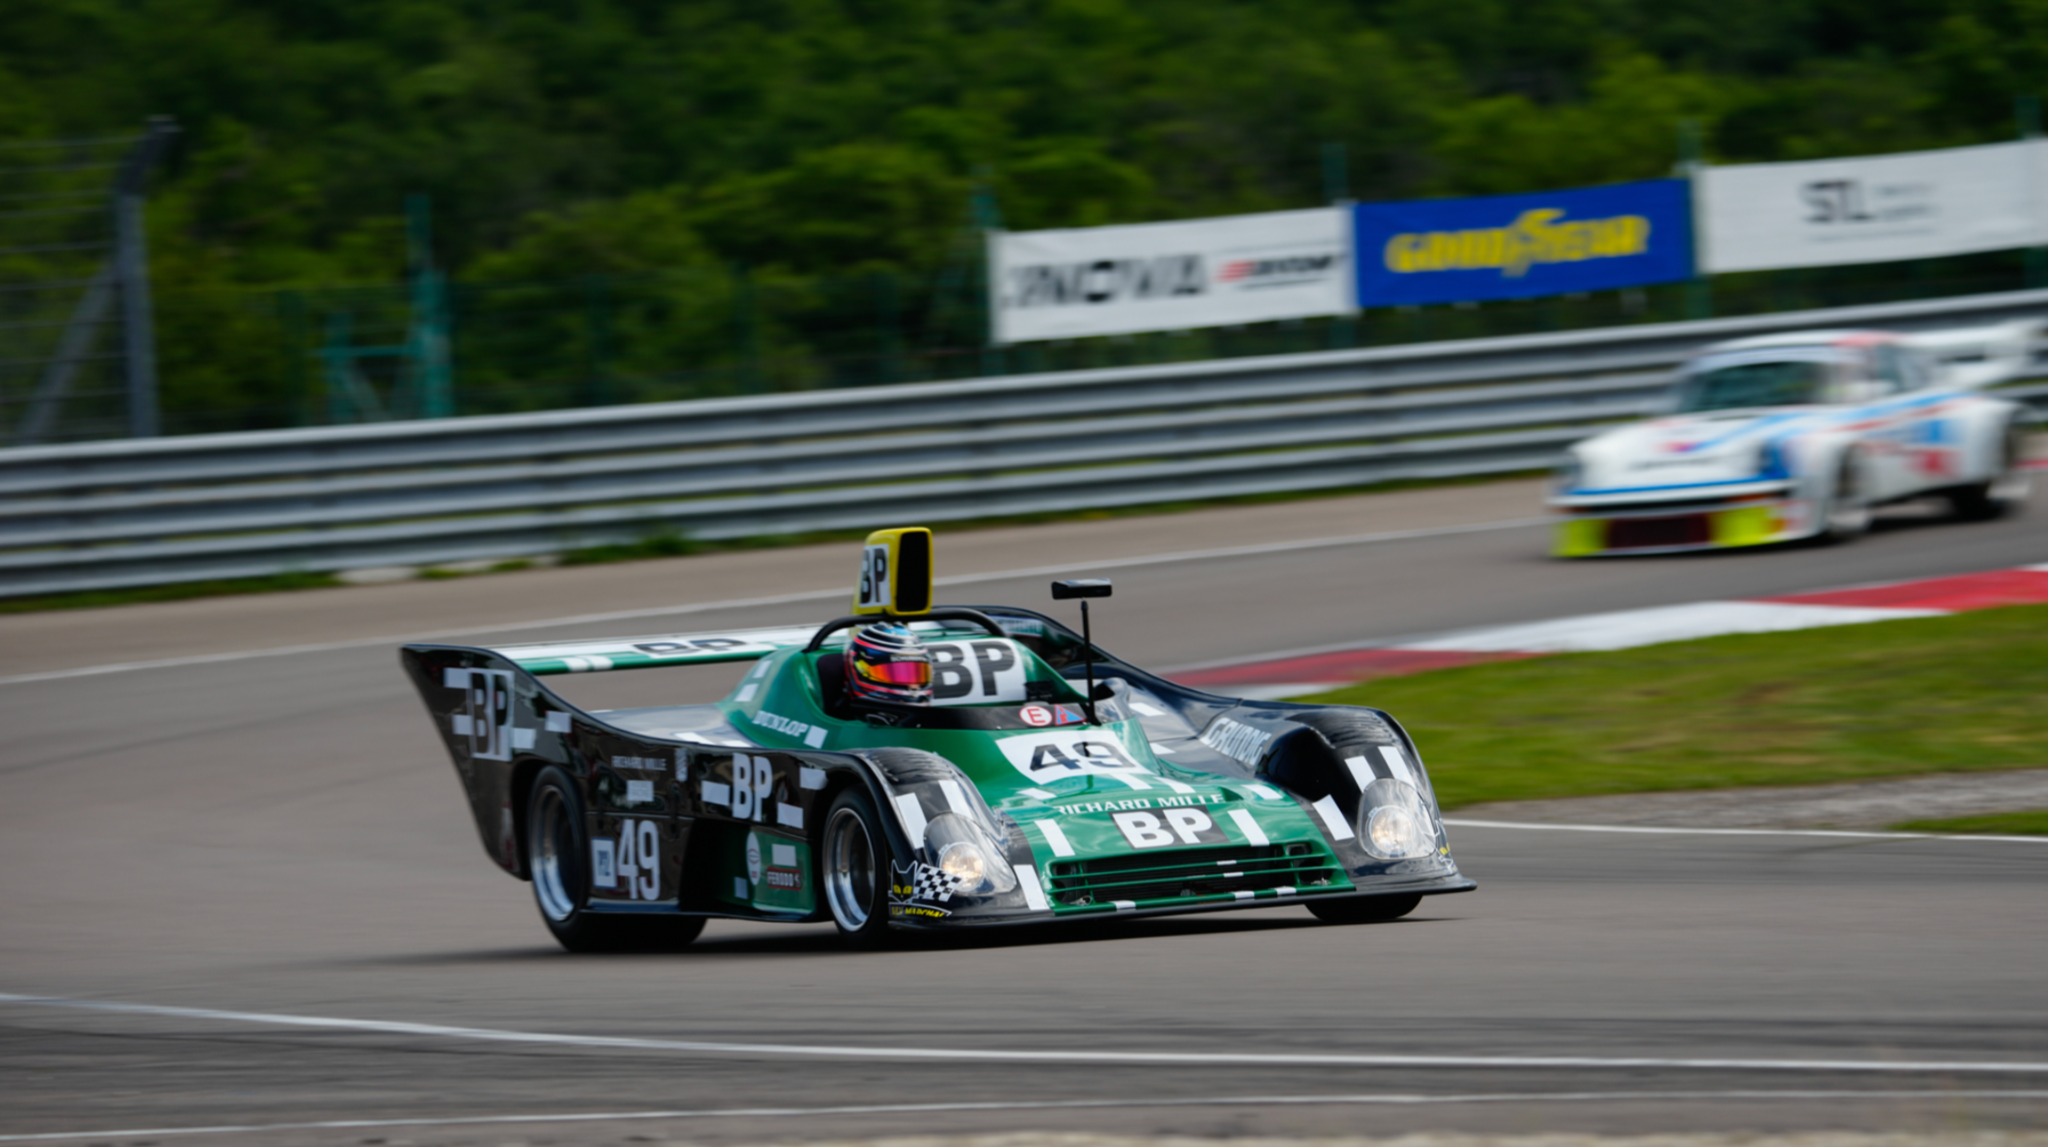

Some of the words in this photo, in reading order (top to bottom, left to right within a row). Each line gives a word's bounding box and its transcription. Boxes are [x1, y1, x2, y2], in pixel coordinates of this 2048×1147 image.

[860, 547, 887, 605] BP
[930, 641, 1016, 699] BP
[467, 668, 514, 761] BP
[752, 710, 810, 737] DUNLOP
[1029, 741, 1137, 772] 49
[1200, 717, 1272, 766] GRUNDIG
[732, 752, 773, 822] BP
[1052, 797, 1152, 815] RICHARD
[1112, 807, 1213, 849] BP
[617, 819, 660, 900] 49
